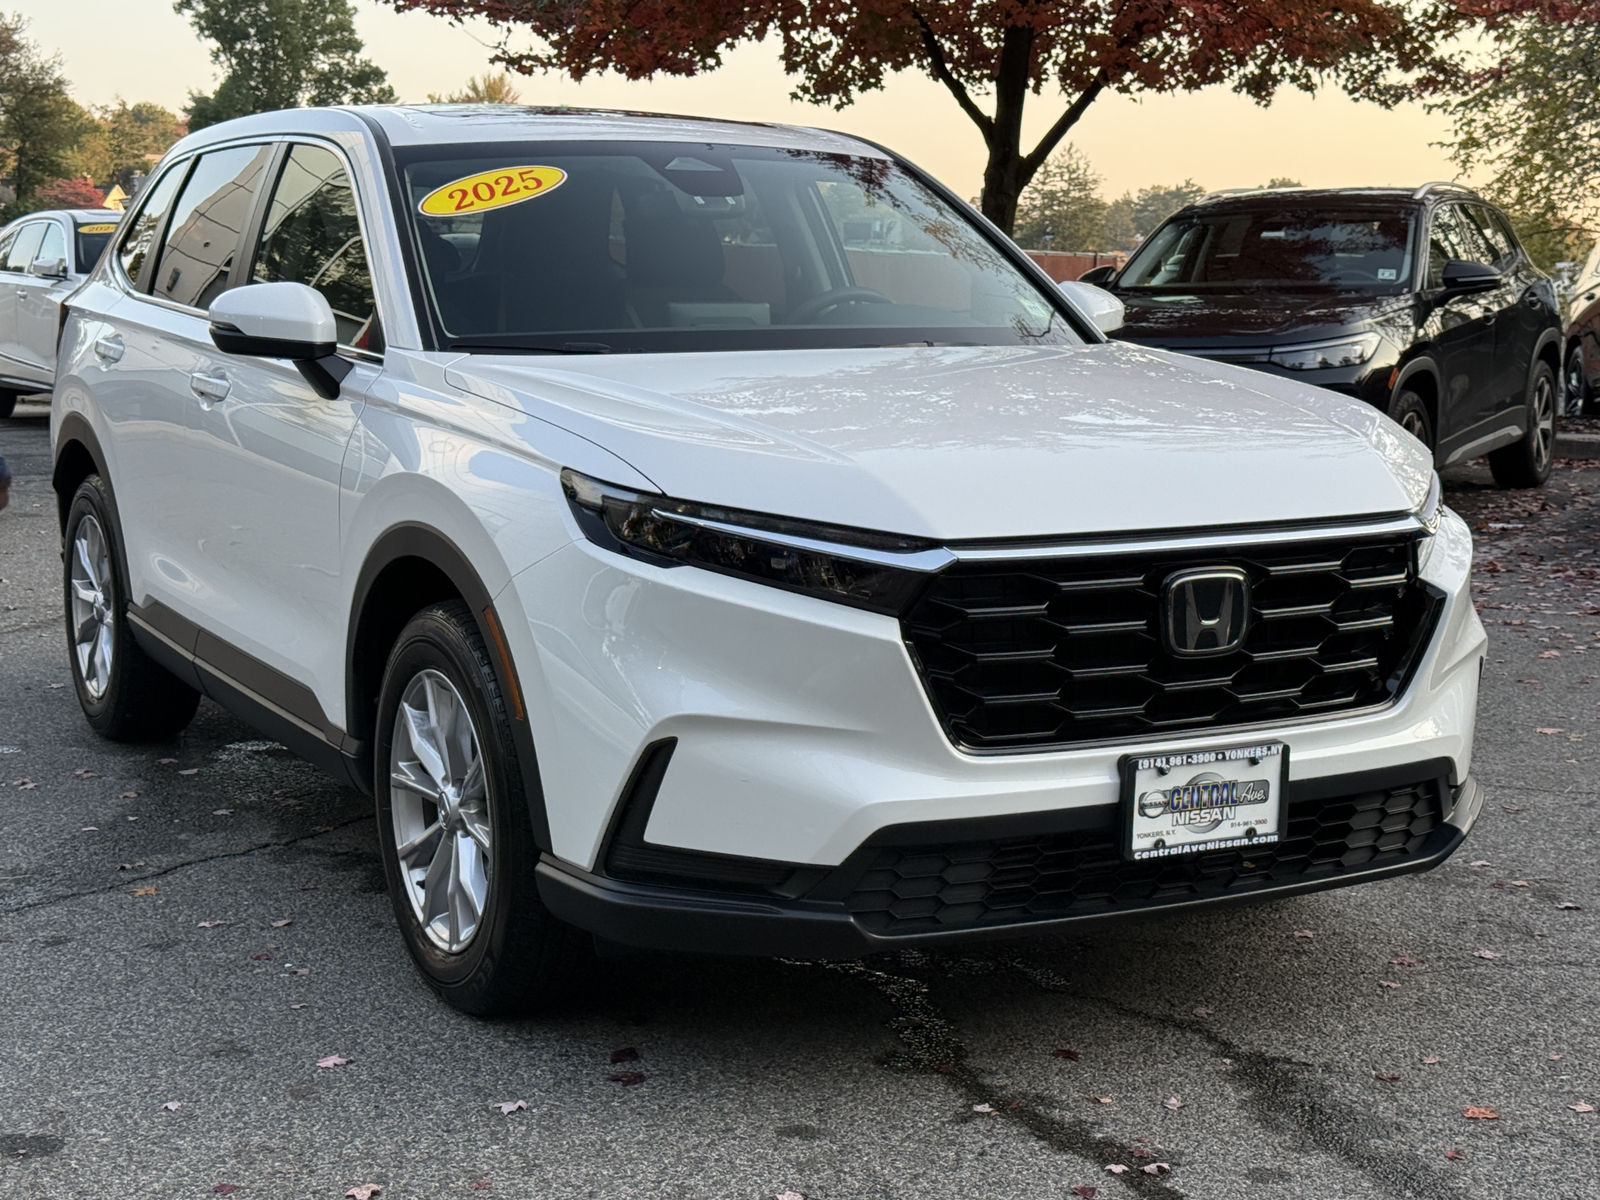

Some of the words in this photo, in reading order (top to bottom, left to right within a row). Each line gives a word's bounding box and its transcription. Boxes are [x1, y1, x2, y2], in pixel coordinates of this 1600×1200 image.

[448, 170, 543, 211] 2025
[1169, 753, 1216, 766] 961-3900
[1171, 780, 1240, 811] CENTRAL
[1240, 783, 1266, 803] Ave.
[1172, 805, 1237, 827] NISSAN
[1230, 818, 1268, 828] 914-961-3900
[1136, 830, 1165, 839] YONKERS,
